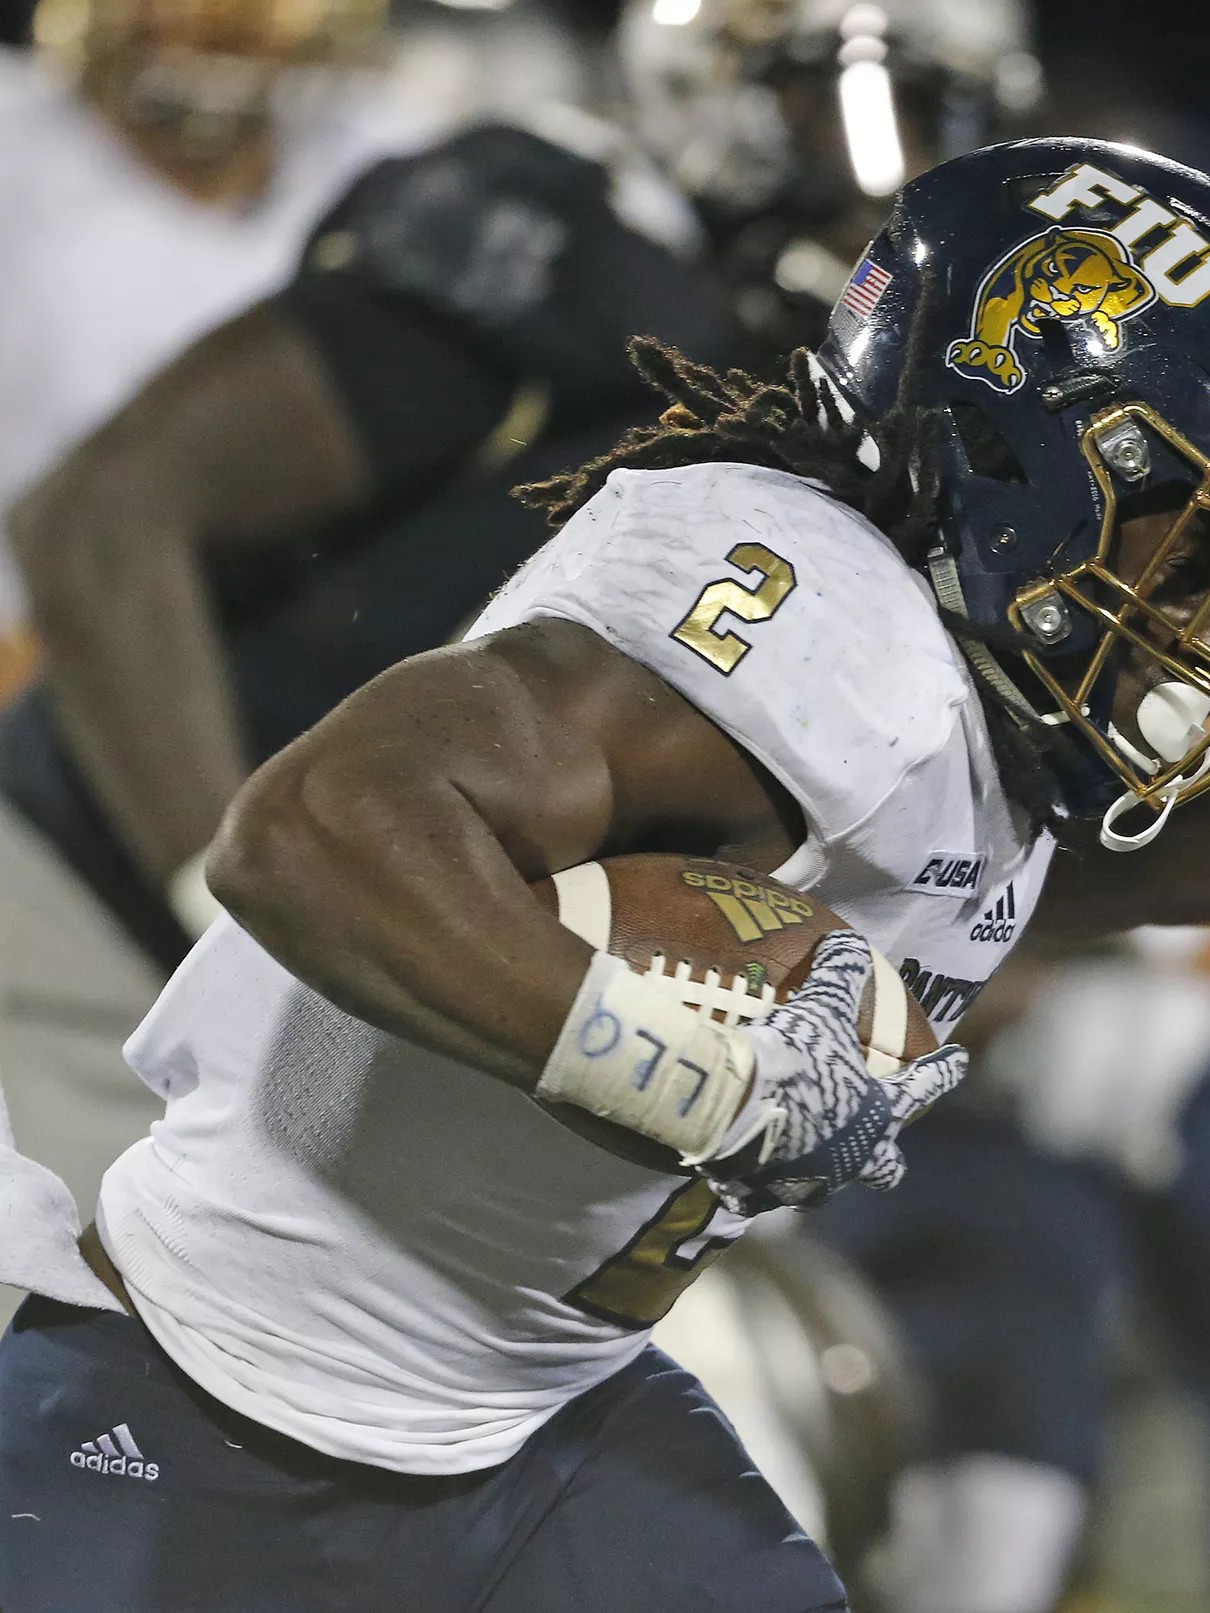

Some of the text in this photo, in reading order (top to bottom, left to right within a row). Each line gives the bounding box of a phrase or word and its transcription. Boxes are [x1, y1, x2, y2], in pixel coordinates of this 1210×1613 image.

[668, 542, 798, 677] 2
[682, 870, 815, 917] adidas
[970, 919, 1016, 943] adida
[69, 1450, 160, 1481] adidas
